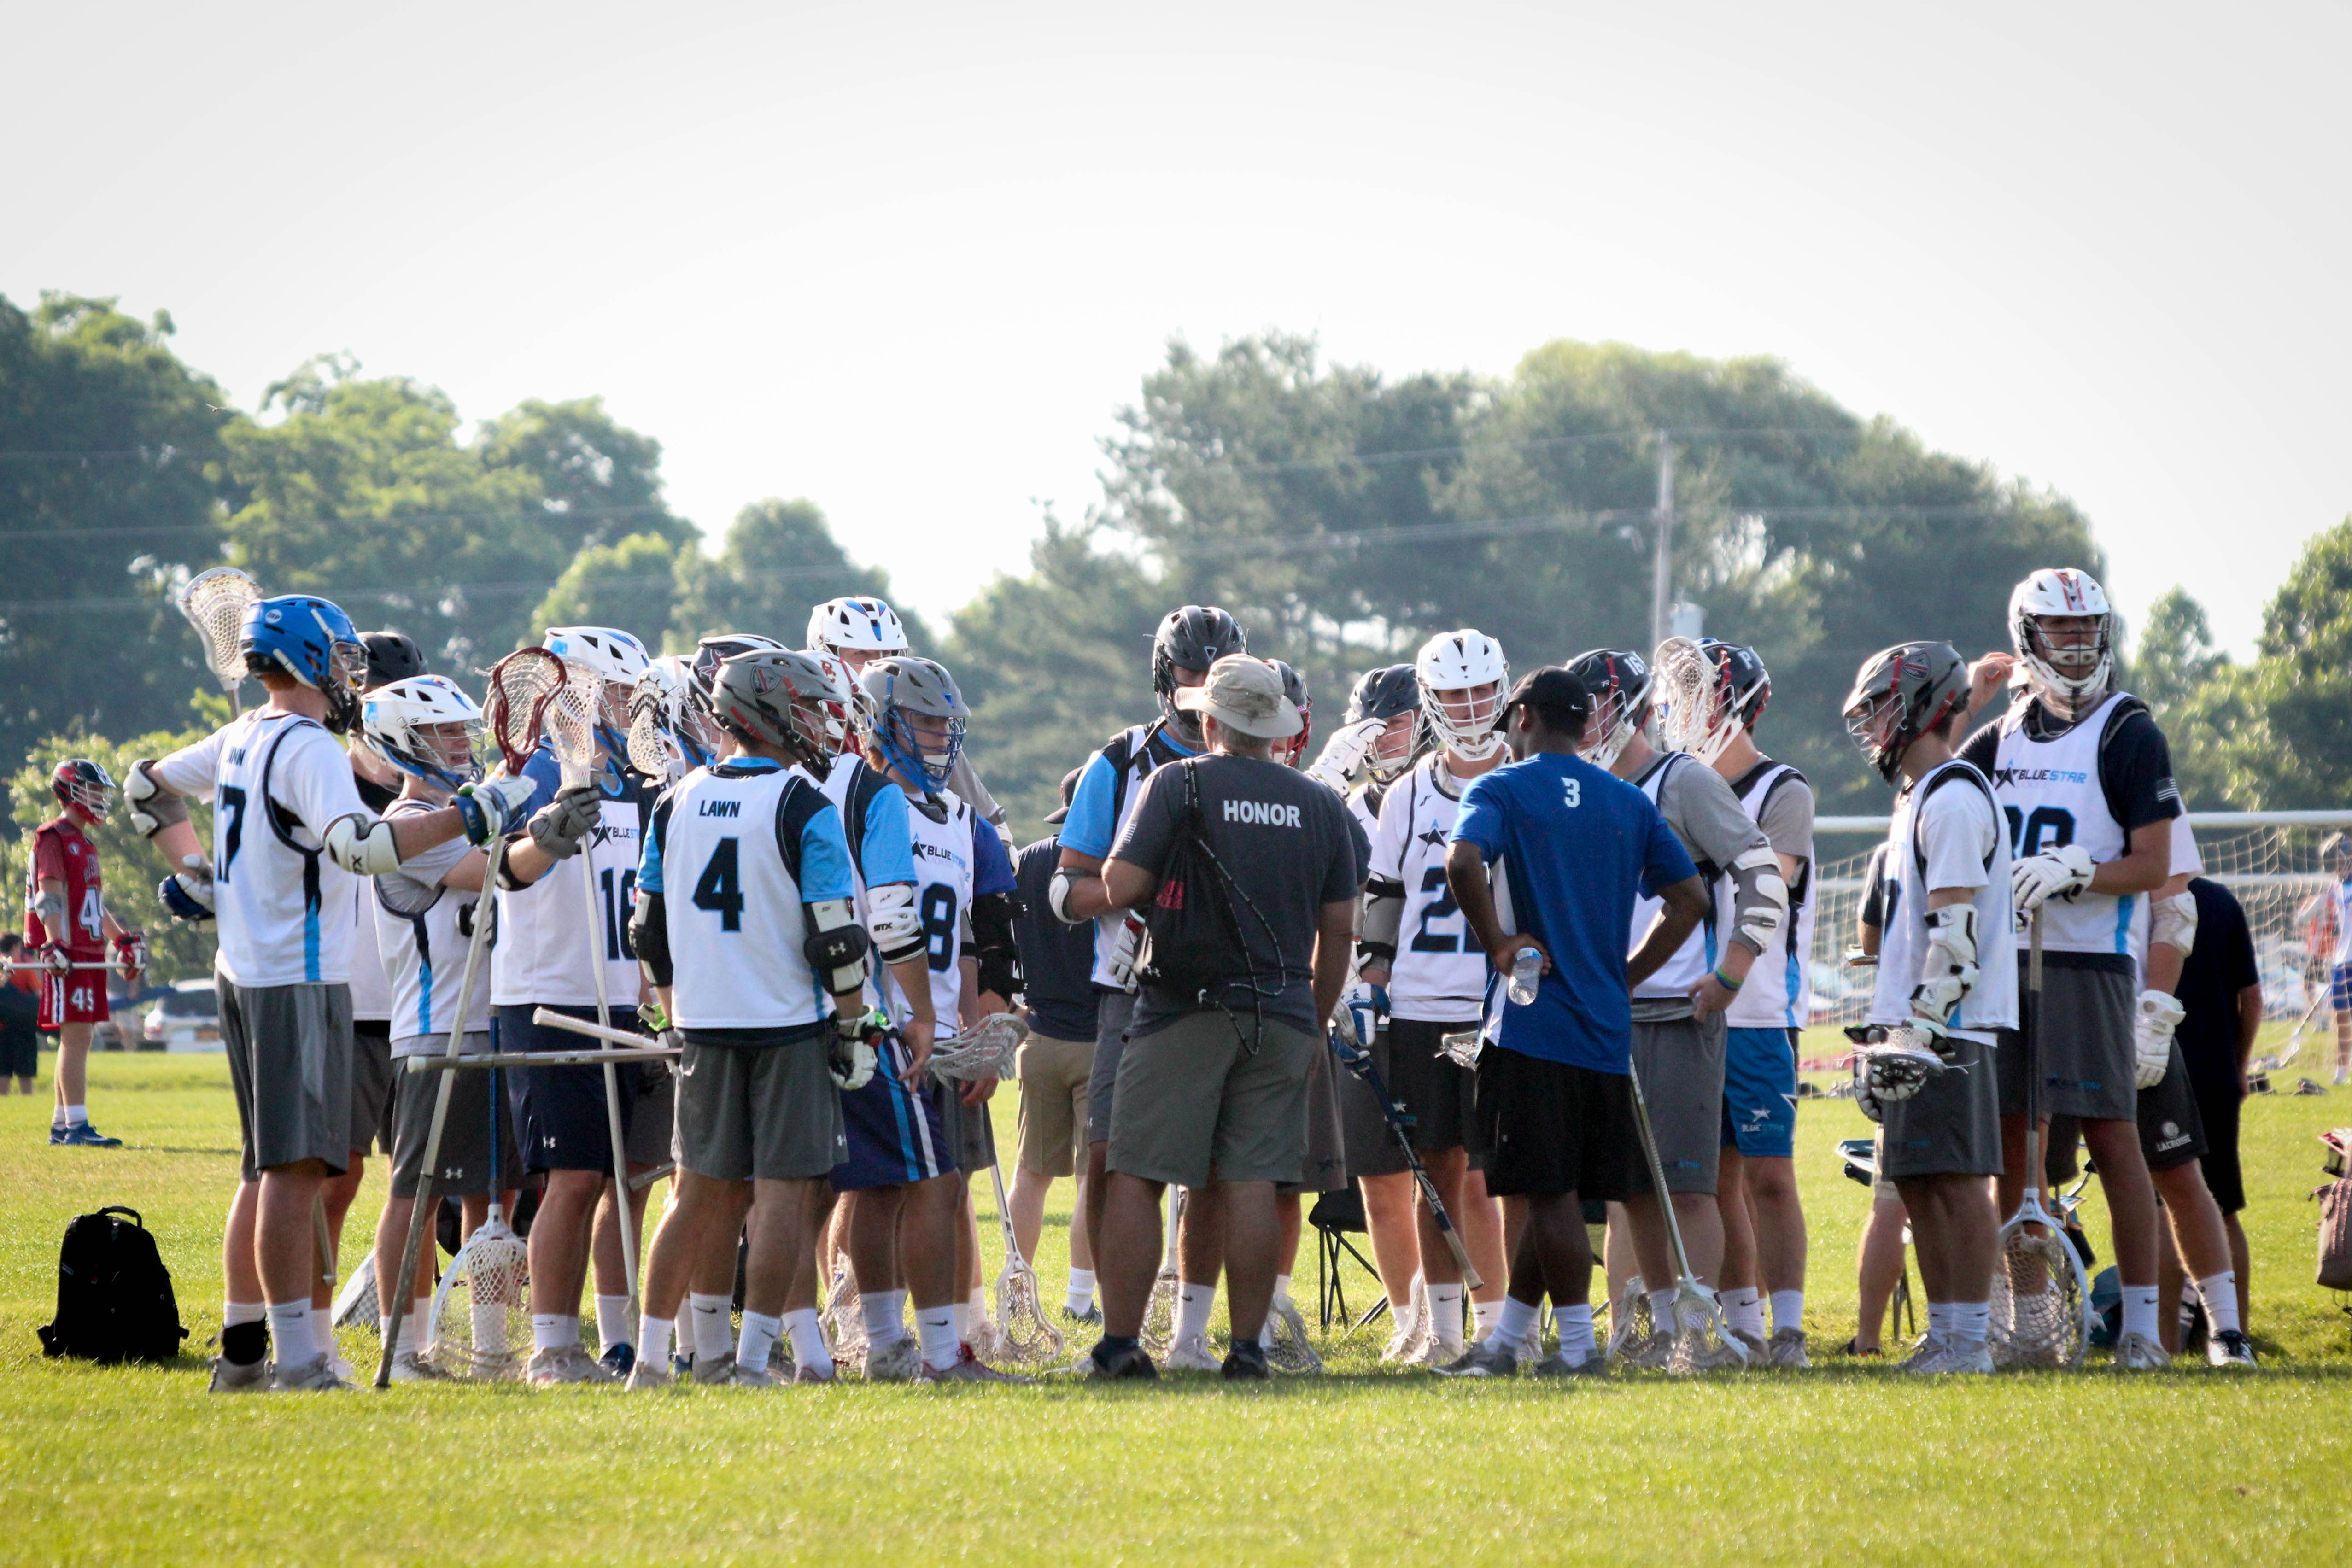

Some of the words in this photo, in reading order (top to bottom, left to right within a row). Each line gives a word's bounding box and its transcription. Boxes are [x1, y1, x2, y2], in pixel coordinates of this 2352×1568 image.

[1624, 656, 1644, 676] 16
[2019, 769, 2087, 784] BLUESTAR
[1561, 777, 1580, 808] 3
[699, 800, 741, 818] LAWN
[1223, 800, 1302, 828] HONOR
[691, 836, 745, 933] 4
[79, 886, 104, 940] 4
[873, 922, 893, 932] STX
[920, 881, 957, 973] 8
